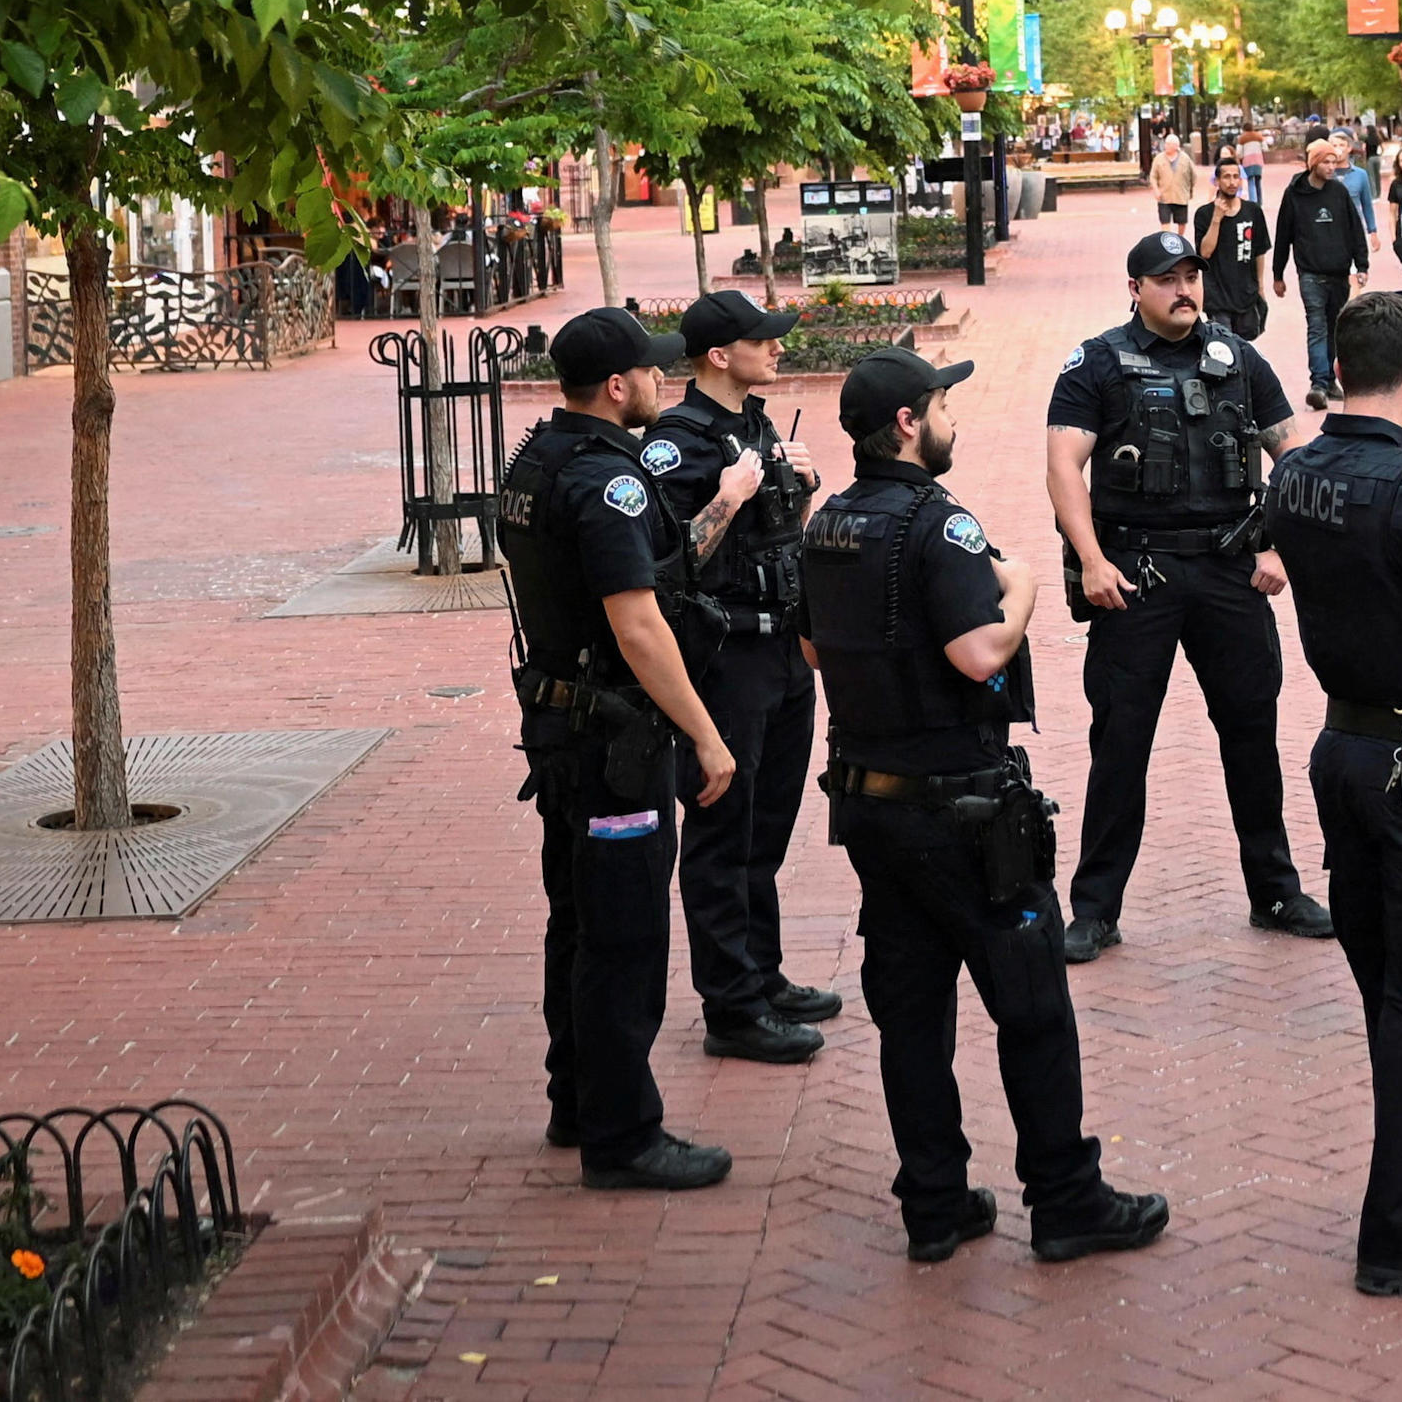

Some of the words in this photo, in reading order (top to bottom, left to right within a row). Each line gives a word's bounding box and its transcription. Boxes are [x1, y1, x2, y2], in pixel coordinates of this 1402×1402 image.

[608, 477, 643, 494] BOULDER
[1277, 468, 1347, 526] POLICE
[500, 487, 533, 527] OLICE
[619, 500, 643, 515] POLICE
[806, 512, 867, 549] POLICE
